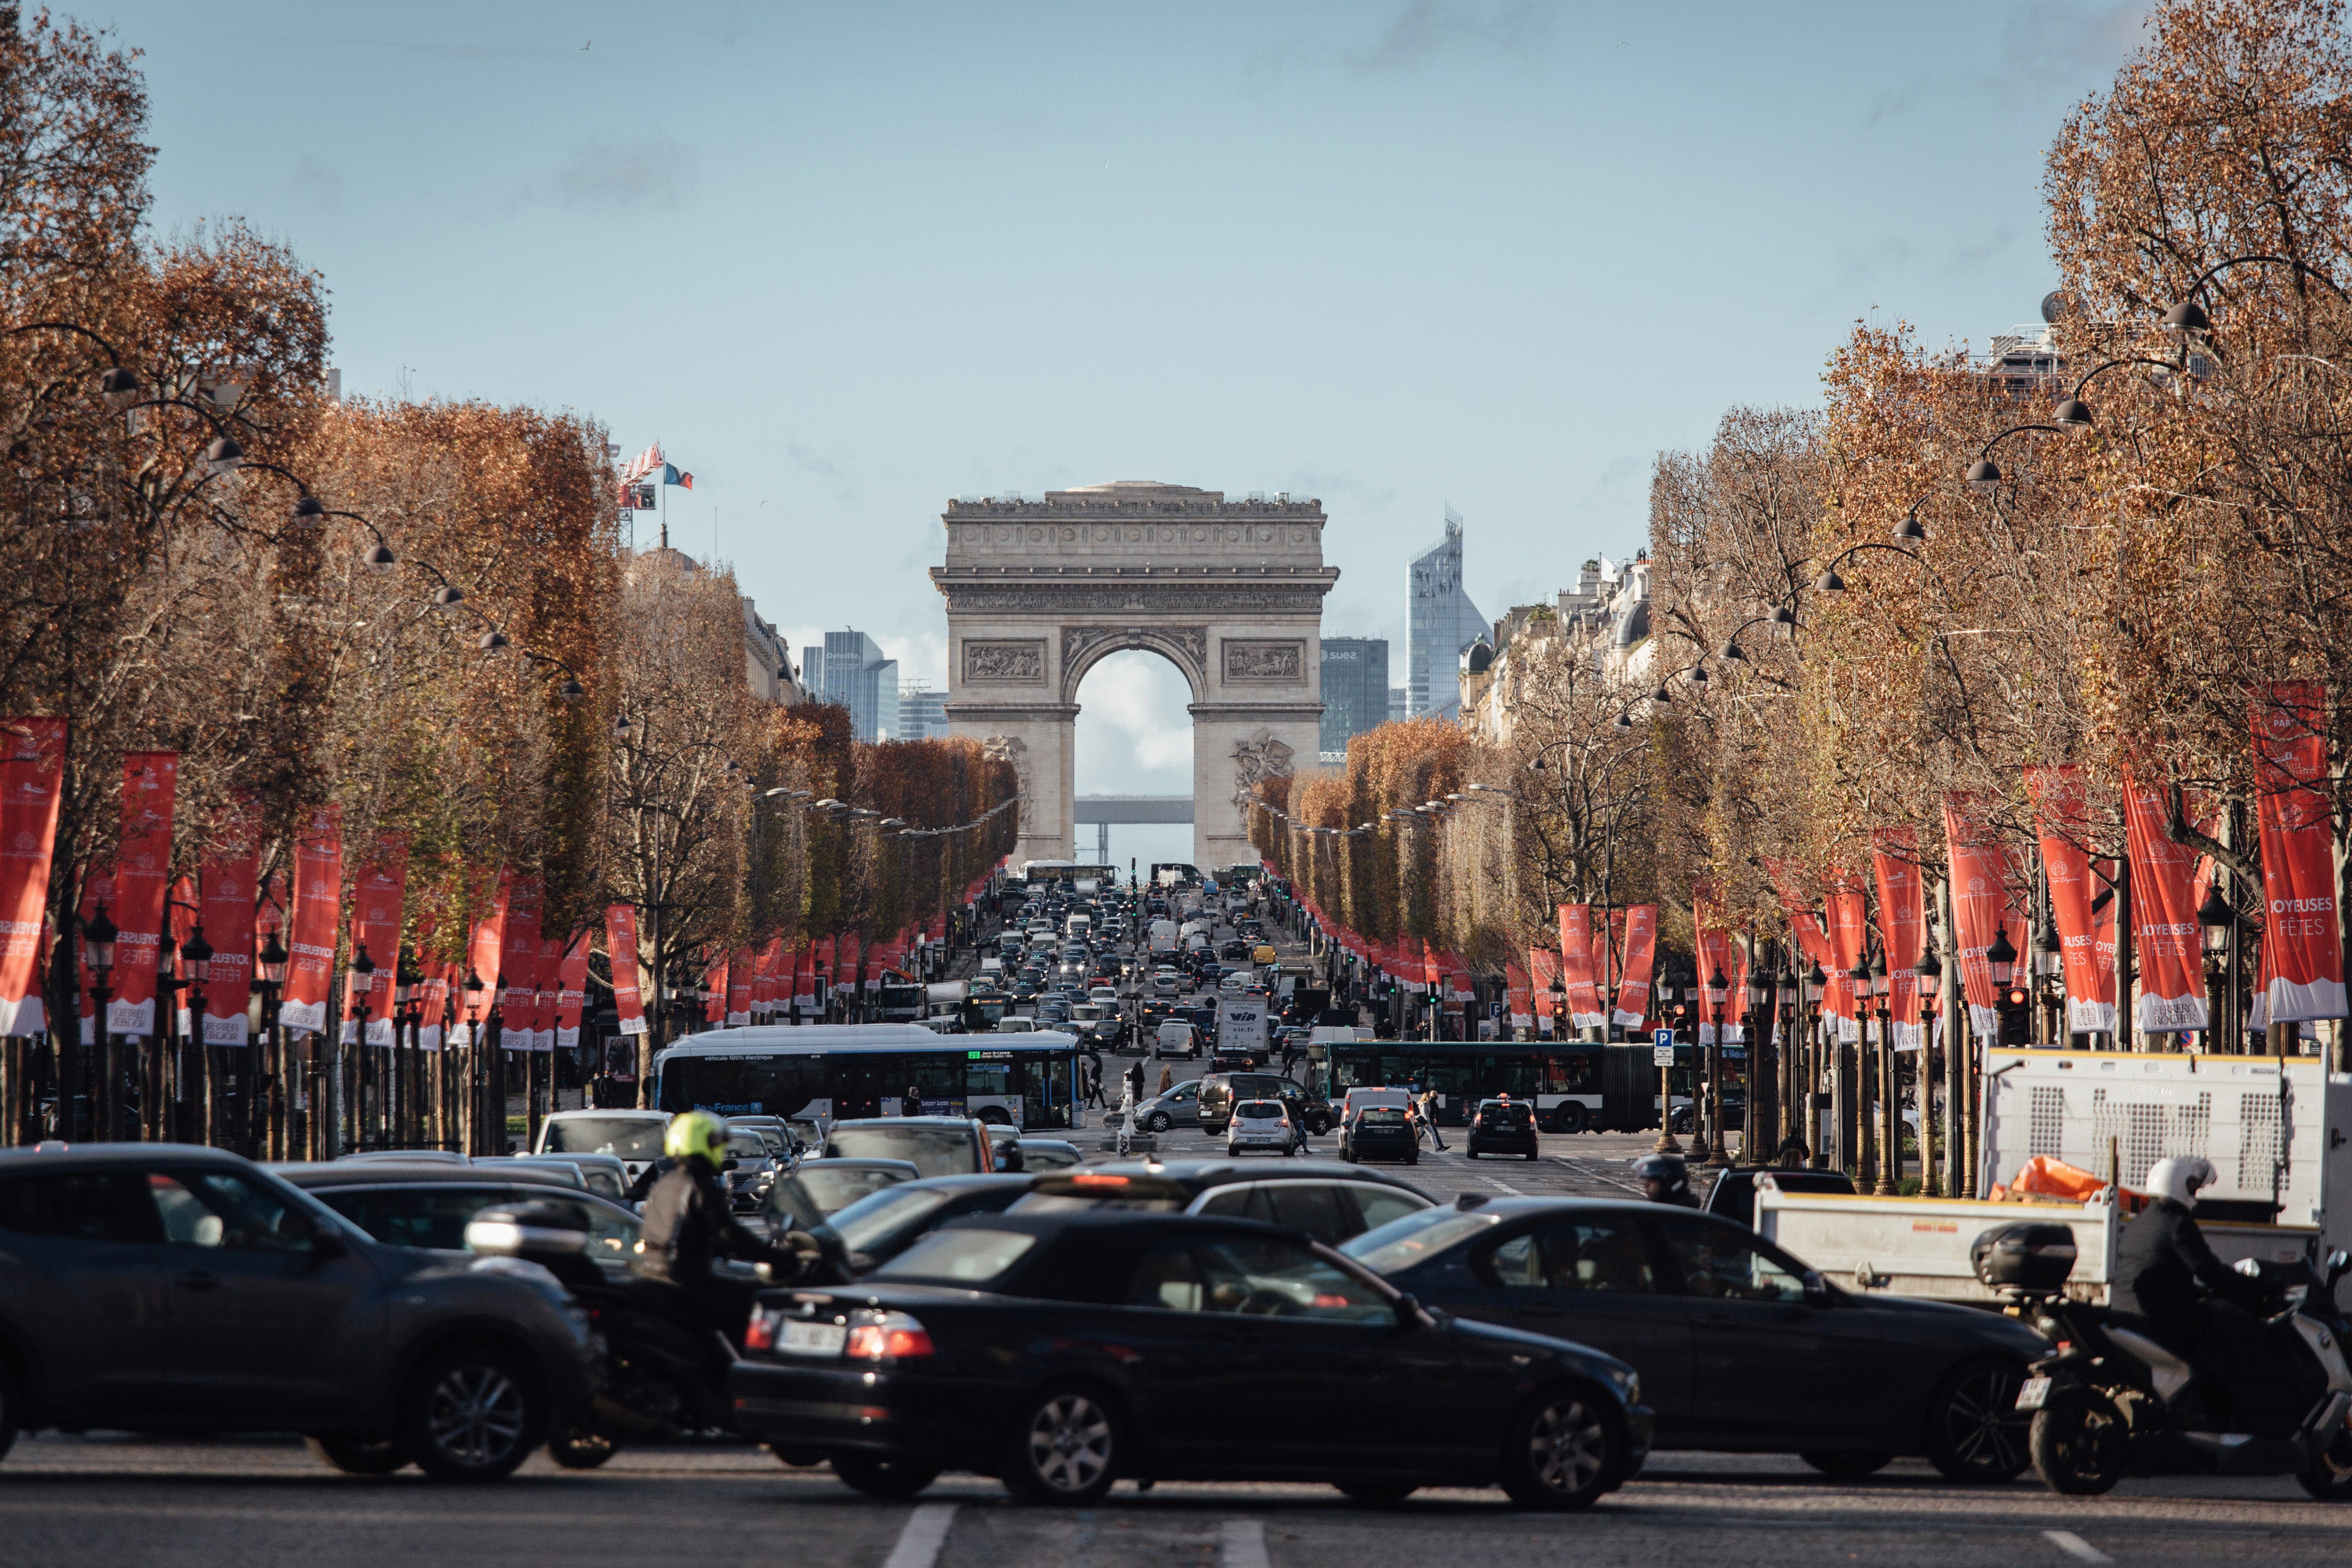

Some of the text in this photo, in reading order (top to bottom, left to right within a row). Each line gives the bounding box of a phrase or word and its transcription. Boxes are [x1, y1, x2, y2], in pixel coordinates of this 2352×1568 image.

[2270, 897, 2333, 913] JOYEUSES
[2140, 922, 2194, 937] JOYEUSES
[2280, 917, 2324, 937] FÊTES
[2151, 939, 2187, 957] FÊTES
[1568, 980, 1594, 989] JOYEUSES
[1623, 980, 1649, 988] JOYEUSES
[1573, 989, 1591, 998] FÊTES
[1626, 988, 1644, 997] FÊTES
[2154, 1004, 2197, 1015] FERRERO
[2154, 1015, 2198, 1025] ROCHER
[1659, 1032, 1668, 1044] P
